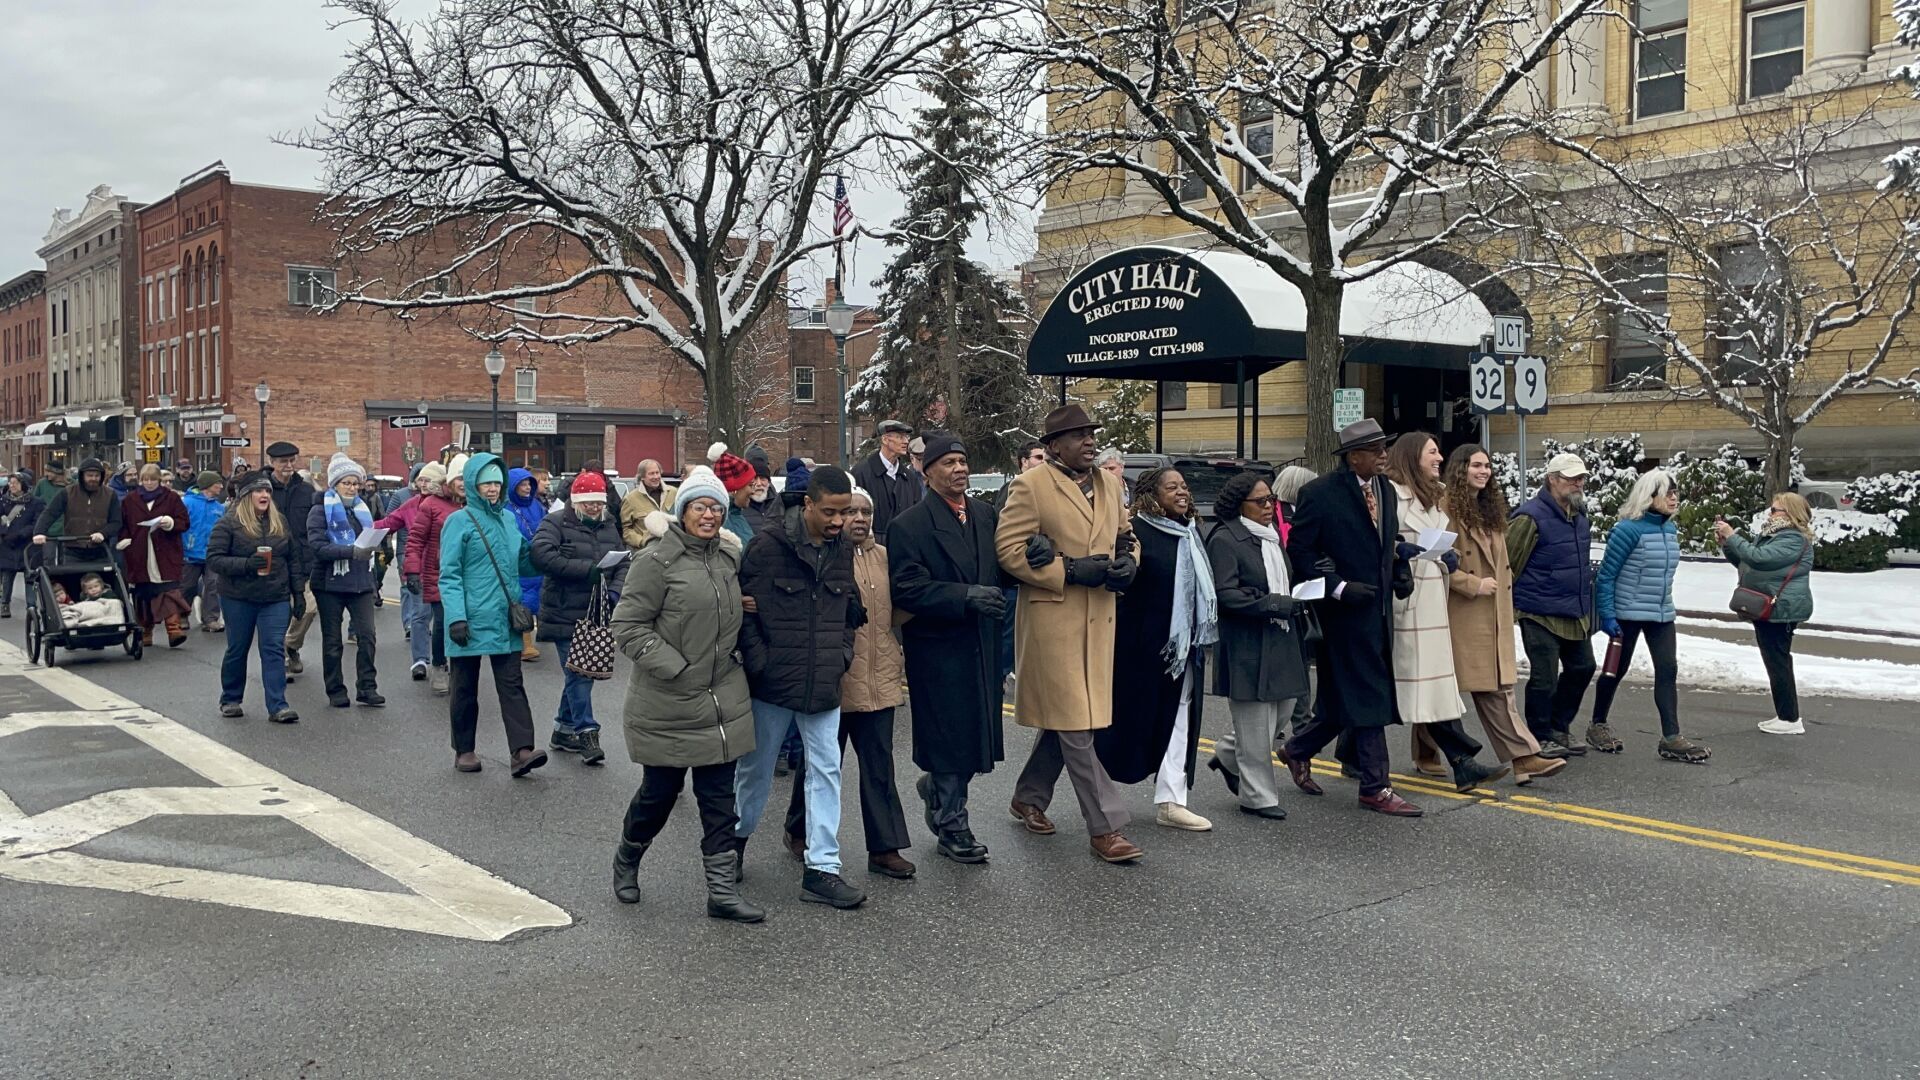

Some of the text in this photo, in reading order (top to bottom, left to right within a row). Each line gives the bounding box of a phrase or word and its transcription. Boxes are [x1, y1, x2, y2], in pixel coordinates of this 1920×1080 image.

[1068, 263, 1201, 313] CITY HALL
[1083, 296, 1185, 325] ERECTED 1900
[1089, 326, 1178, 346] INCORPORATED
[1497, 323, 1523, 348] JCT
[1066, 341, 1204, 364] VILLAGE-1839 CITY-1908
[1475, 367, 1502, 399] 32
[1524, 368, 1537, 399] 9
